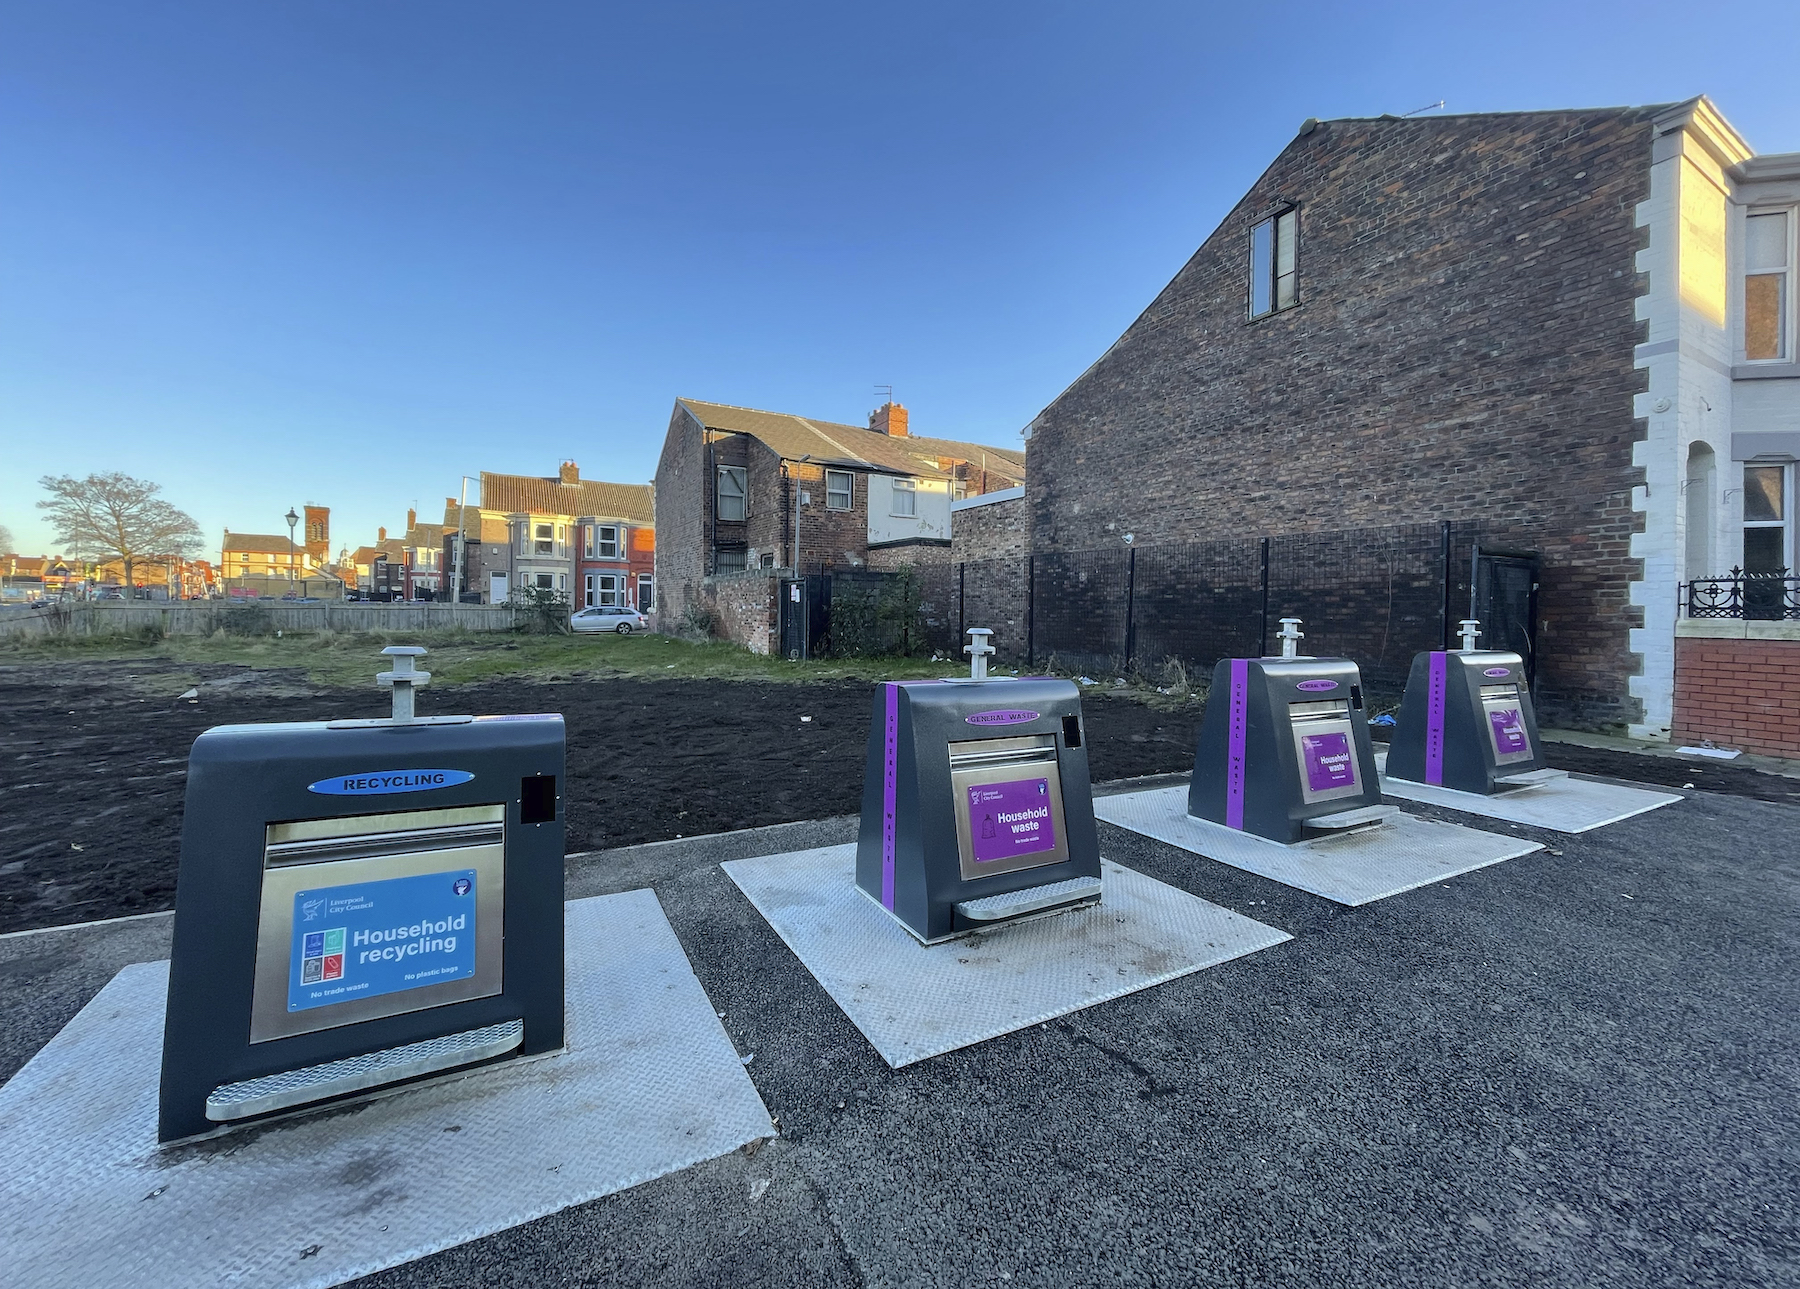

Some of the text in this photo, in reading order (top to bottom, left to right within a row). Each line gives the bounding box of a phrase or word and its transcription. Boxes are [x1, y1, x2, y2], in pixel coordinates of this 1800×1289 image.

[970, 712, 1036, 723] GENERAL WASTE
[1320, 752, 1350, 765] Household
[1233, 756, 1241, 794] WASTE
[1328, 763, 1346, 772] waste
[343, 773, 445, 791] RECYCLING
[997, 805, 1049, 824] Household
[1010, 820, 1040, 834] waste
[329, 902, 374, 914] City Council
[330, 896, 364, 907] Liverpool
[353, 913, 466, 947] Household
[359, 936, 457, 965] recycling
[404, 965, 459, 981] No plastic bags
[310, 982, 370, 999] No trade waste
